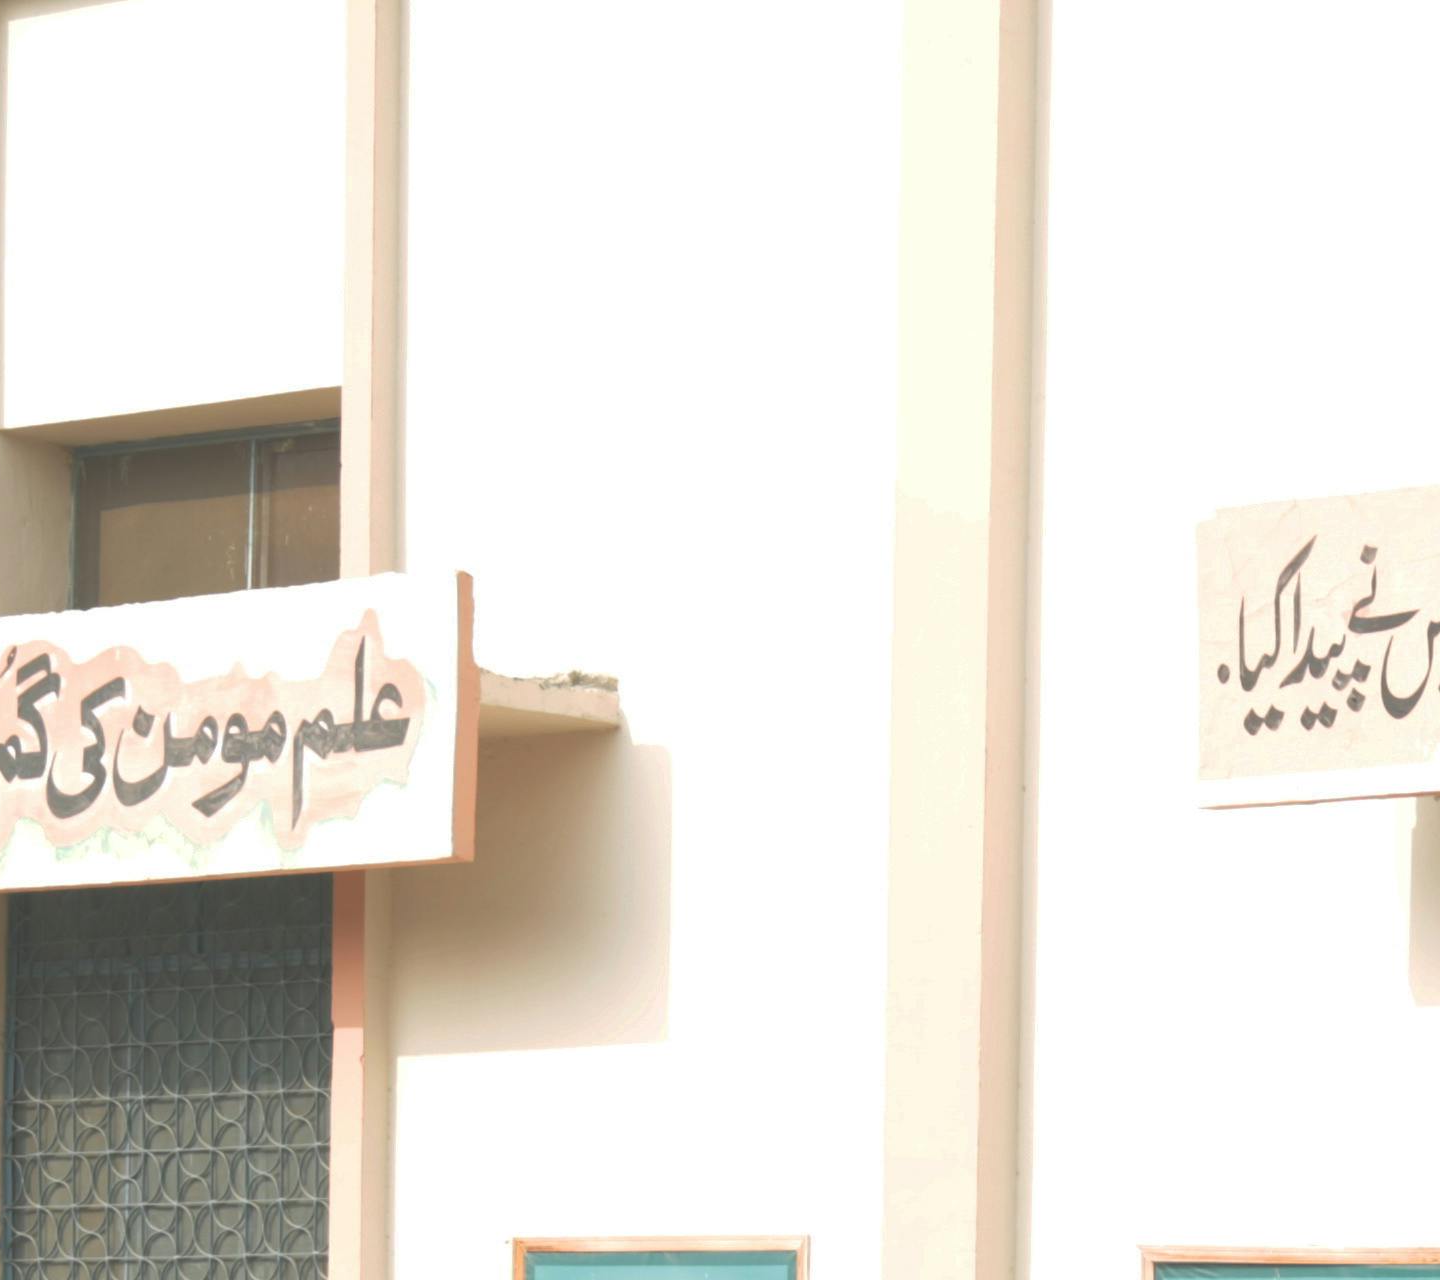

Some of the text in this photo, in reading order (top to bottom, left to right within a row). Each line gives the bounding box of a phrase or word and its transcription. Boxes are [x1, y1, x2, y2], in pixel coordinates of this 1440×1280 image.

[1279, 572, 1371, 731] پیدا
[1346, 543, 1420, 635] نے
[46, 676, 126, 819] کی
[114, 704, 287, 818] مومن
[292, 635, 411, 831] علم
